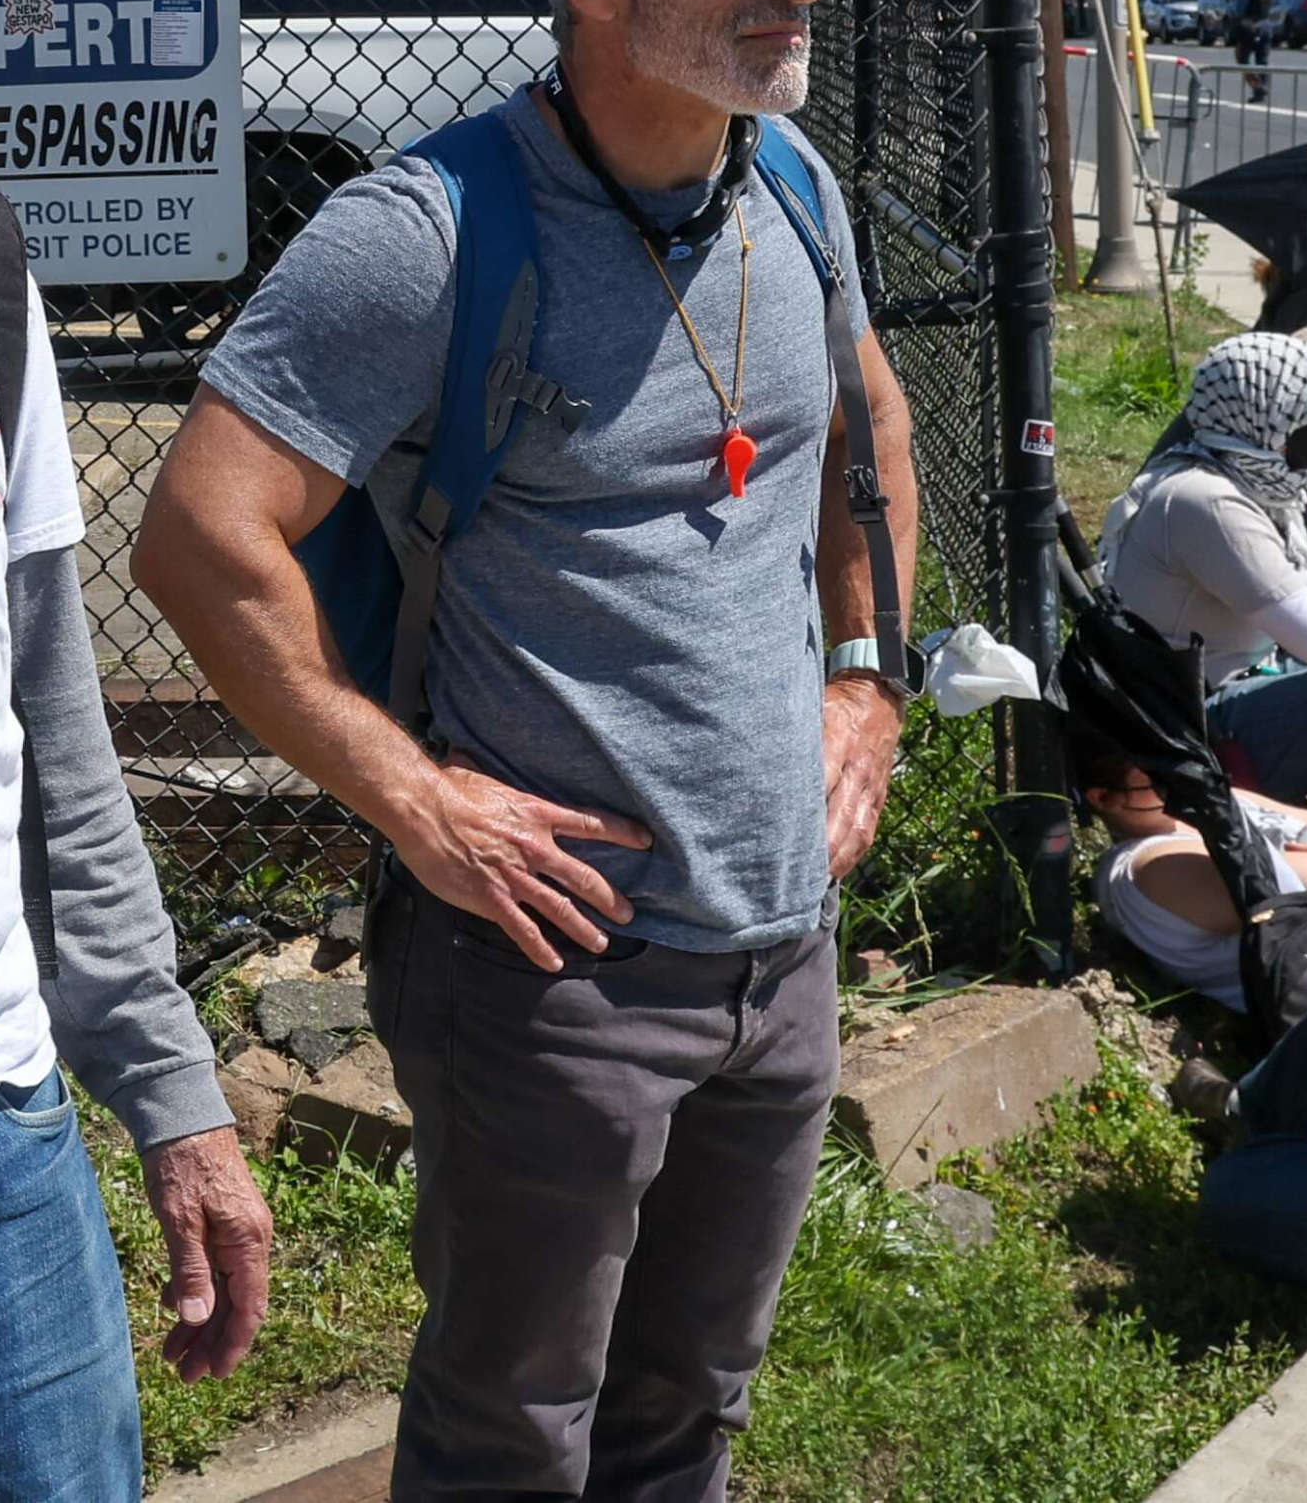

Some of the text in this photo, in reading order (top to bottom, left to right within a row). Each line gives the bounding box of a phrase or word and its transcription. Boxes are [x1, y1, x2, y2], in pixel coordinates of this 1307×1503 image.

[16, 4, 41, 15] NEW
[9, 13, 50, 27] GESTAPO
[157, 197, 195, 221] BY
[83, 231, 192, 259] POLICE
